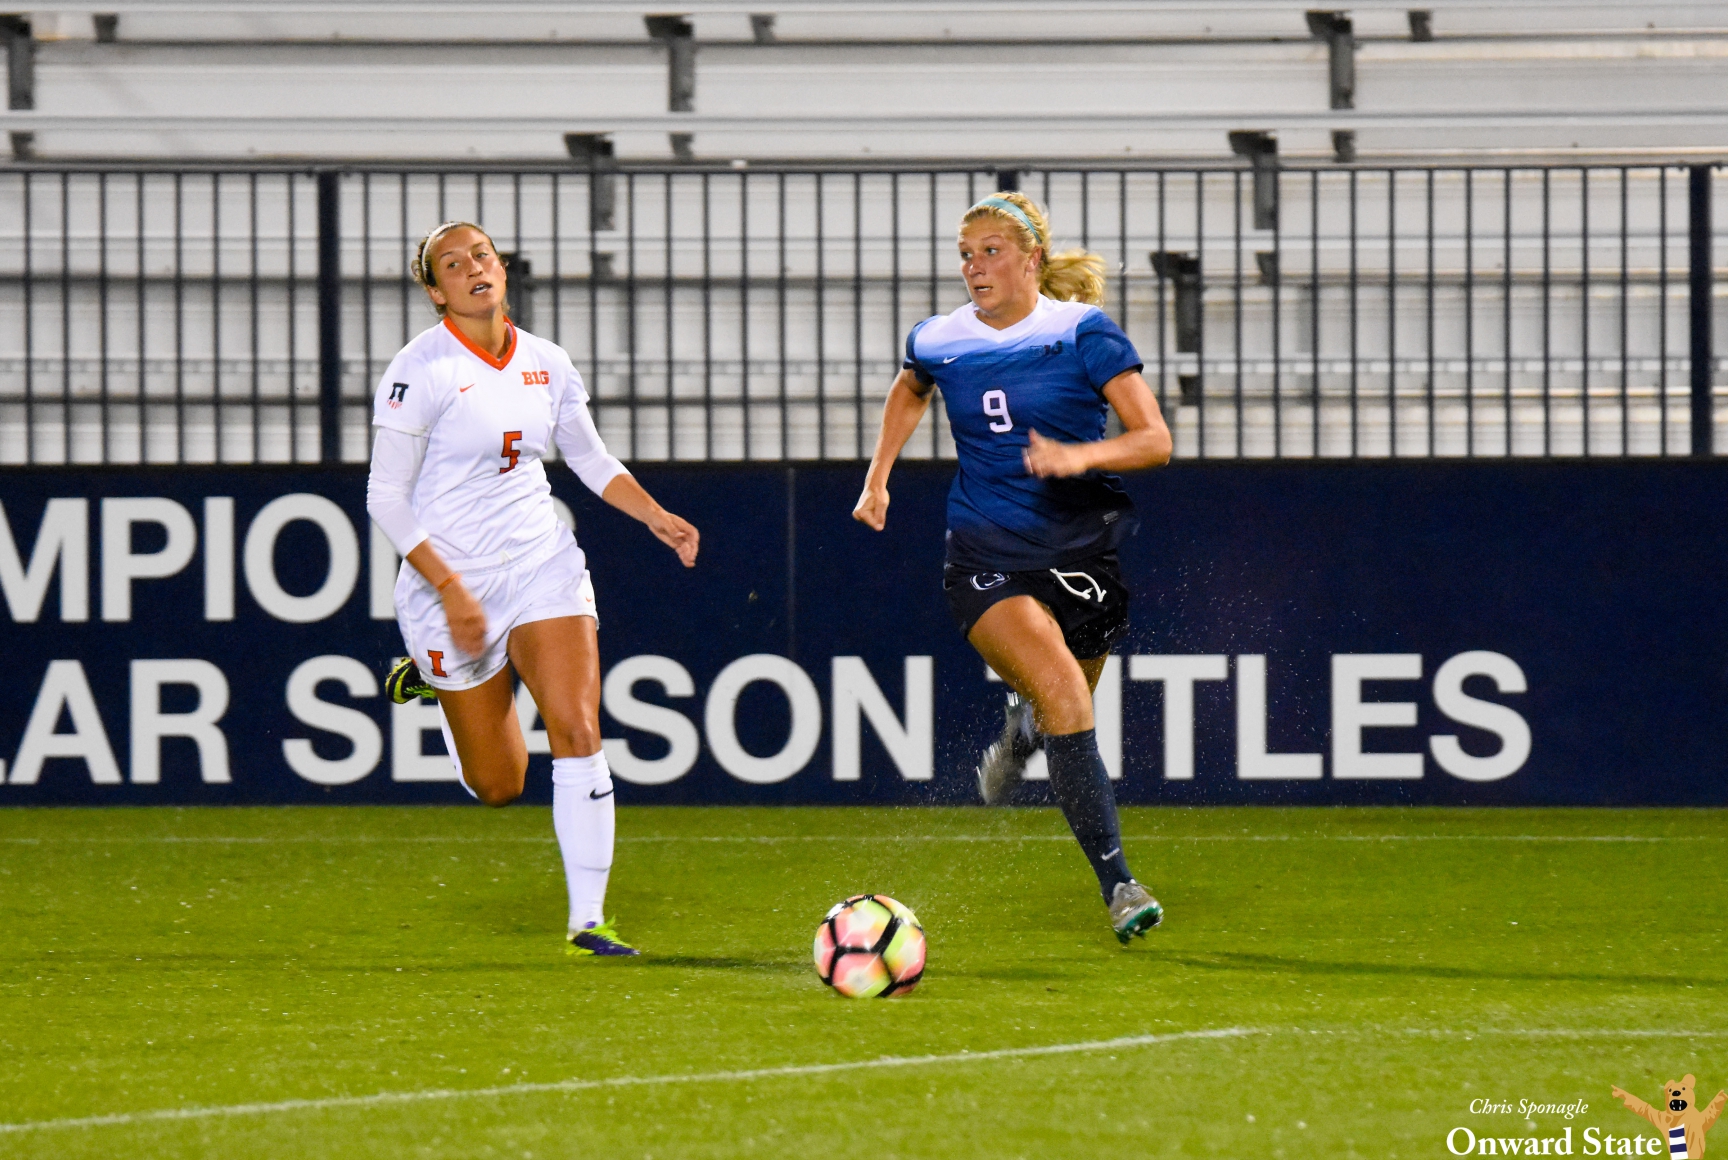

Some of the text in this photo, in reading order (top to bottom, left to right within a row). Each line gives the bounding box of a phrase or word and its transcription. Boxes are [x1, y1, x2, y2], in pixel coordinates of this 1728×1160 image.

[982, 389, 1014, 434] 9
[499, 430, 523, 474] 5
[427, 650, 448, 678] I
[0, 655, 232, 784] AR
[986, 649, 1532, 783] ITLES
